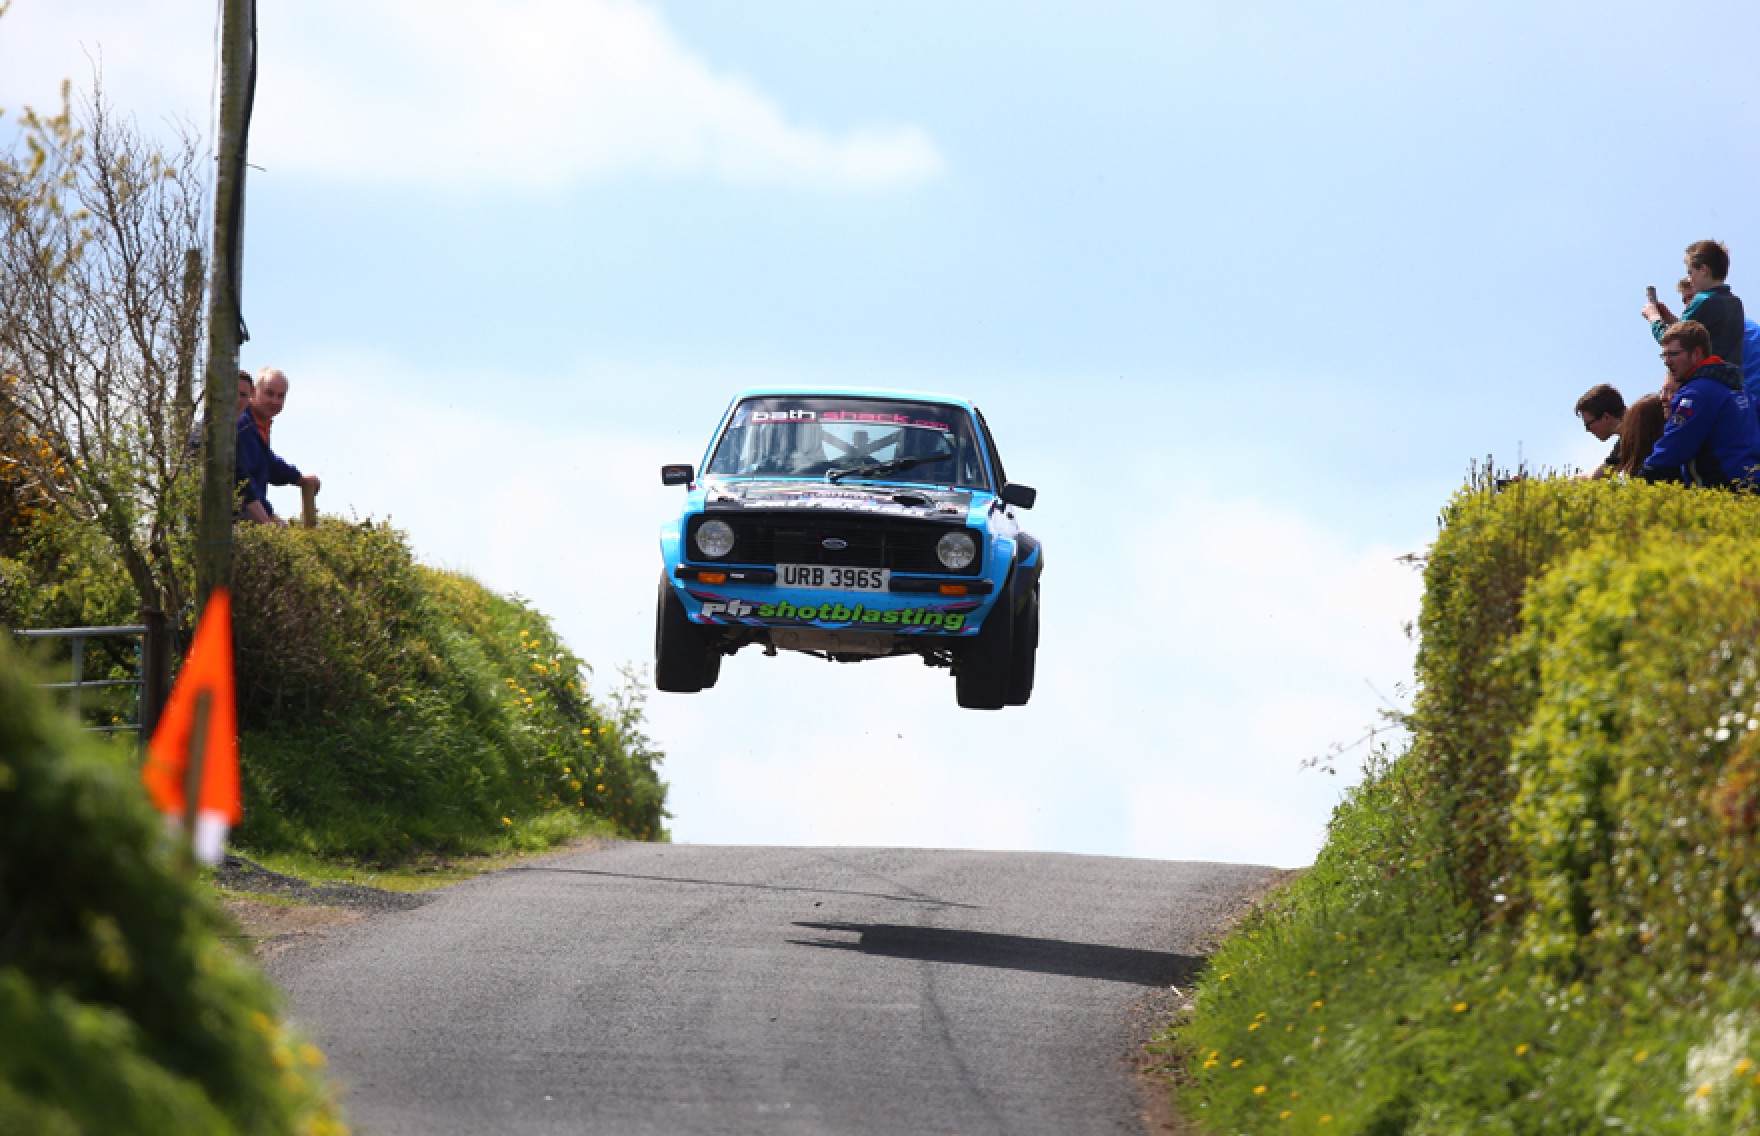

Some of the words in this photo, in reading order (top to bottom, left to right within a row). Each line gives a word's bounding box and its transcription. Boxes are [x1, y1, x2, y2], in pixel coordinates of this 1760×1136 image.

[784, 565, 825, 587] URB
[829, 568, 882, 589] 396S
[758, 600, 966, 630] shotblasting
